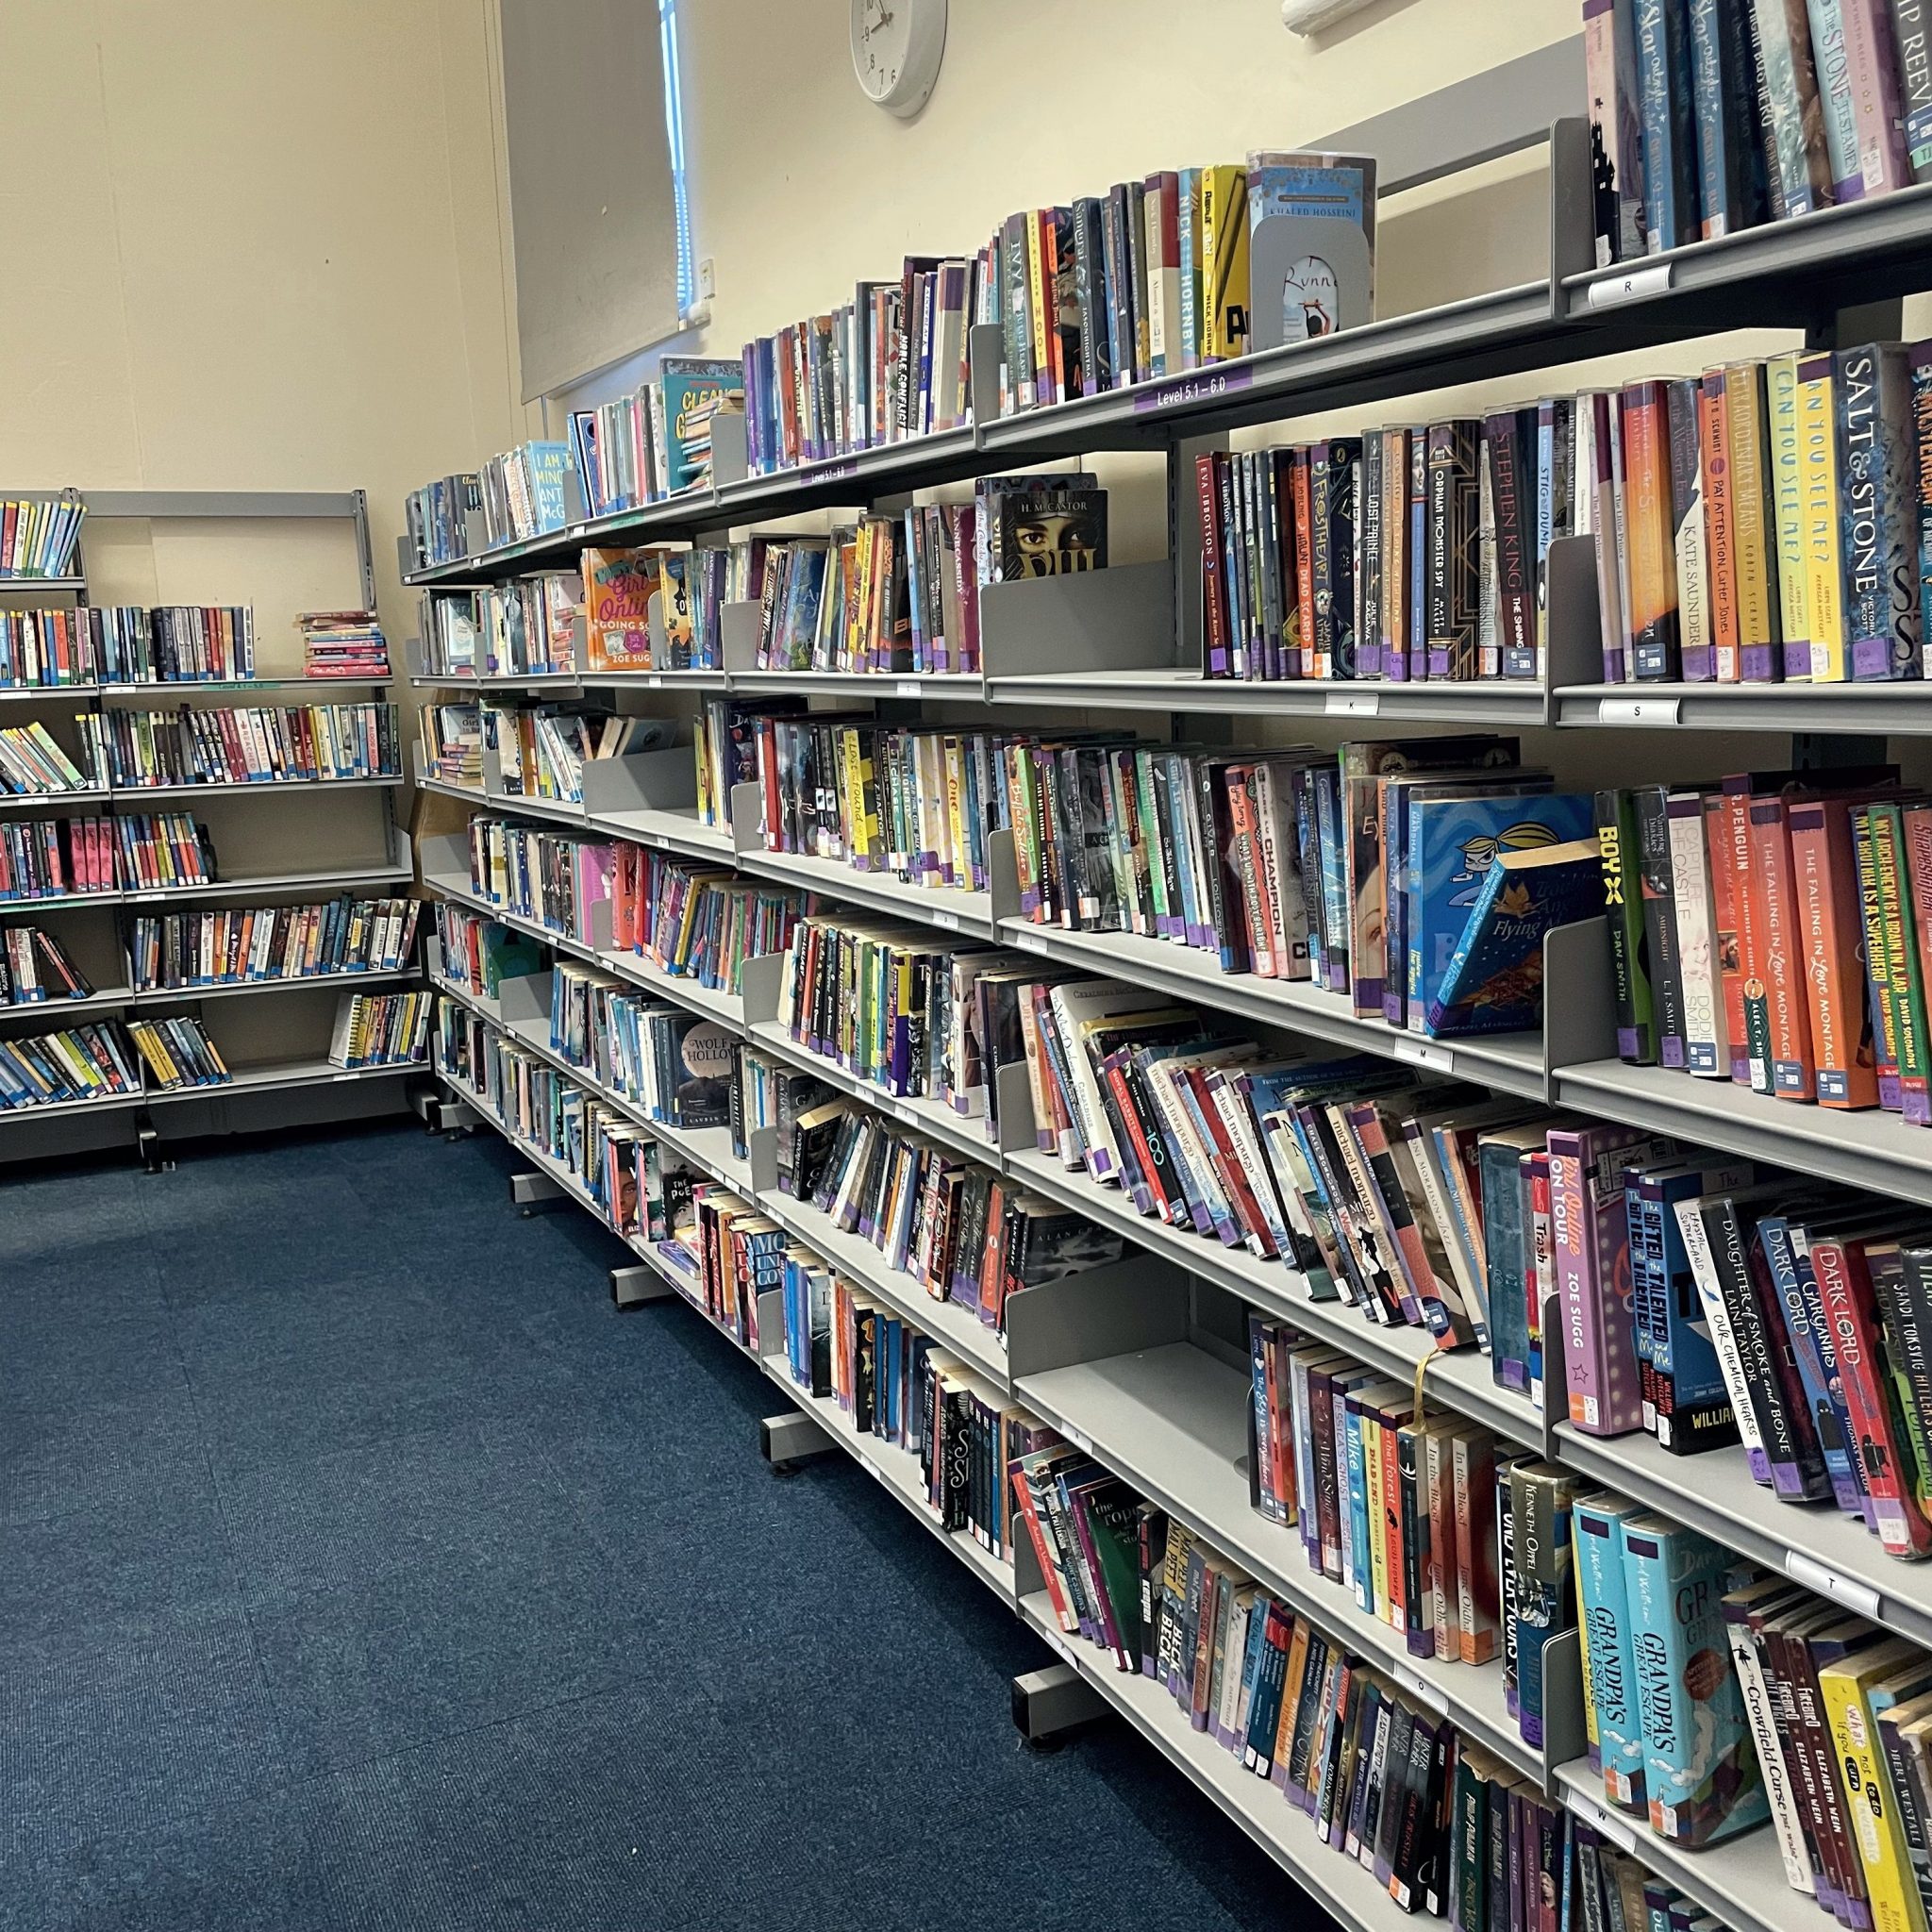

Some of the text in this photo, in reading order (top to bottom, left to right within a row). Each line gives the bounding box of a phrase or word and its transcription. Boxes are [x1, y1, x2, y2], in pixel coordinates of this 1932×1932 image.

[864, 25, 870, 42] 9
[870, 54, 875, 70] 8
[878, 68, 884, 85] 7
[891, 69, 896, 84] 6
[1822, 8, 1858, 175] The STONE TESTAMEN
[1902, 31, 1932, 114] REEV
[1757, 86, 1774, 128] HERO
[1312, 208, 1357, 218] HOSSEINI
[1009, 240, 1023, 281] IVY
[1074, 201, 1091, 333] Samurai JASON
[1178, 195, 1194, 352] NICK HORNBY
[1624, 281, 1632, 292] R
[897, 335, 908, 428] NOBLE CONFLICT
[1158, 376, 1225, 406] Level 5.1 6.0
[544, 454, 560, 468] AM
[811, 471, 825, 483] Level
[1713, 479, 1725, 498] PAY
[1775, 370, 1802, 563] CAN YOU SEE ME?
[1844, 358, 1878, 592] SALT & STONE
[1047, 501, 1088, 512] CASTOR
[1434, 470, 1444, 513] ORPHAN
[1496, 432, 1523, 588] STEPHEN KING
[1807, 418, 1830, 563] YOU SEE ME?
[1201, 493, 1214, 555] IBBOTSON
[1313, 478, 1329, 584] FROSTHEART
[1434, 515, 1445, 568] MONSTER
[954, 515, 963, 595] ANNE CASSIDY
[1435, 569, 1444, 589] SPY
[606, 574, 648, 603] Girl
[1684, 525, 1702, 645] KATE SAUNDER
[600, 621, 636, 630] GOING
[1300, 600, 1311, 642] SCARED
[1867, 594, 1876, 638] VICTORIA
[613, 655, 652, 663] ZOE SUG
[1634, 706, 1641, 717] S
[1009, 783, 1028, 871] Buffalo Soldier
[1733, 808, 1750, 871] PENGUIN
[1264, 838, 1282, 936] CHAMPION
[1598, 825, 1624, 906] BOY X
[1673, 853, 1690, 921] CASTLE
[1492, 920, 1541, 938] Flying
[1763, 841, 1791, 1059] THE FALLING Love MONTAGE
[1613, 929, 1626, 1002] DAN SMITH
[1805, 848, 1836, 1069] THE FALLING Love MONTAGE
[689, 1039, 727, 1050] WOLF
[1897, 998, 1917, 1069] DAVID SOLOMONS
[1111, 1071, 1124, 1095] ROYAL
[1150, 1067, 1195, 1158] michael morpurgo
[1145, 1131, 1165, 1166] 100
[1229, 1122, 1256, 1174] morpurgo
[1333, 1120, 1377, 1222] michael morpurgo
[671, 1188, 691, 1200] POE
[674, 1178, 687, 1190] THE
[1550, 1158, 1570, 1245] ON TOUR
[1535, 1222, 1549, 1264] Trash
[1563, 1191, 1584, 1257] Online
[1679, 1213, 1705, 1271] SUTHERLAND
[1633, 1261, 1653, 1331] TALENTED
[1643, 1212, 1670, 1343] GIFTED, TALENTED
[1764, 1227, 1810, 1336] DARK LORD
[1567, 1271, 1584, 1349] ZOE SUGG
[1712, 1314, 1731, 1345] OUR
[1722, 1219, 1791, 1455] DAUGHTER SMOKE and BONE
[1724, 1289, 1758, 1384] LAINI TAYLOR
[1818, 1251, 1861, 1365] DARK LORD
[1891, 1283, 1924, 1371] SANDI TOKSVIG
[1723, 1344, 1746, 1397] CHEMICAL
[1734, 1398, 1758, 1436] HEARTS
[1259, 1430, 1271, 1485] everywhere
[1332, 1396, 1350, 1505] JESSICA'S GHOST
[1345, 1427, 1360, 1472] Mike
[1384, 1462, 1397, 1505] forest
[1429, 1487, 1441, 1524] Blood
[1457, 1491, 1469, 1526] Blood
[1165, 1522, 1179, 1583] MAL PEET
[1524, 1482, 1540, 1572] KENNETH OPPEL
[1158, 1612, 1174, 1662] BECK
[1170, 1624, 1183, 1674] BECK
[1585, 1607, 1605, 1712] GREAT ESCAPE
[1593, 1606, 1627, 1725] GRANDPA'S
[1298, 1692, 1318, 1737] GOOD
[1632, 1632, 1653, 1740] GREAT ESCAPE
[1642, 1632, 1677, 1754] GRANDPA'S
[1746, 1685, 1790, 1811] Crowfield Curse
[1794, 1741, 1824, 1824] ELIZABETH WEIN
[1814, 1749, 1843, 1834] ELIZABETH WEIN
[1464, 1821, 1476, 1865] PULLMAN
[1597, 1808, 1607, 1821] W
[1899, 1788, 1923, 1844] WESTALL
